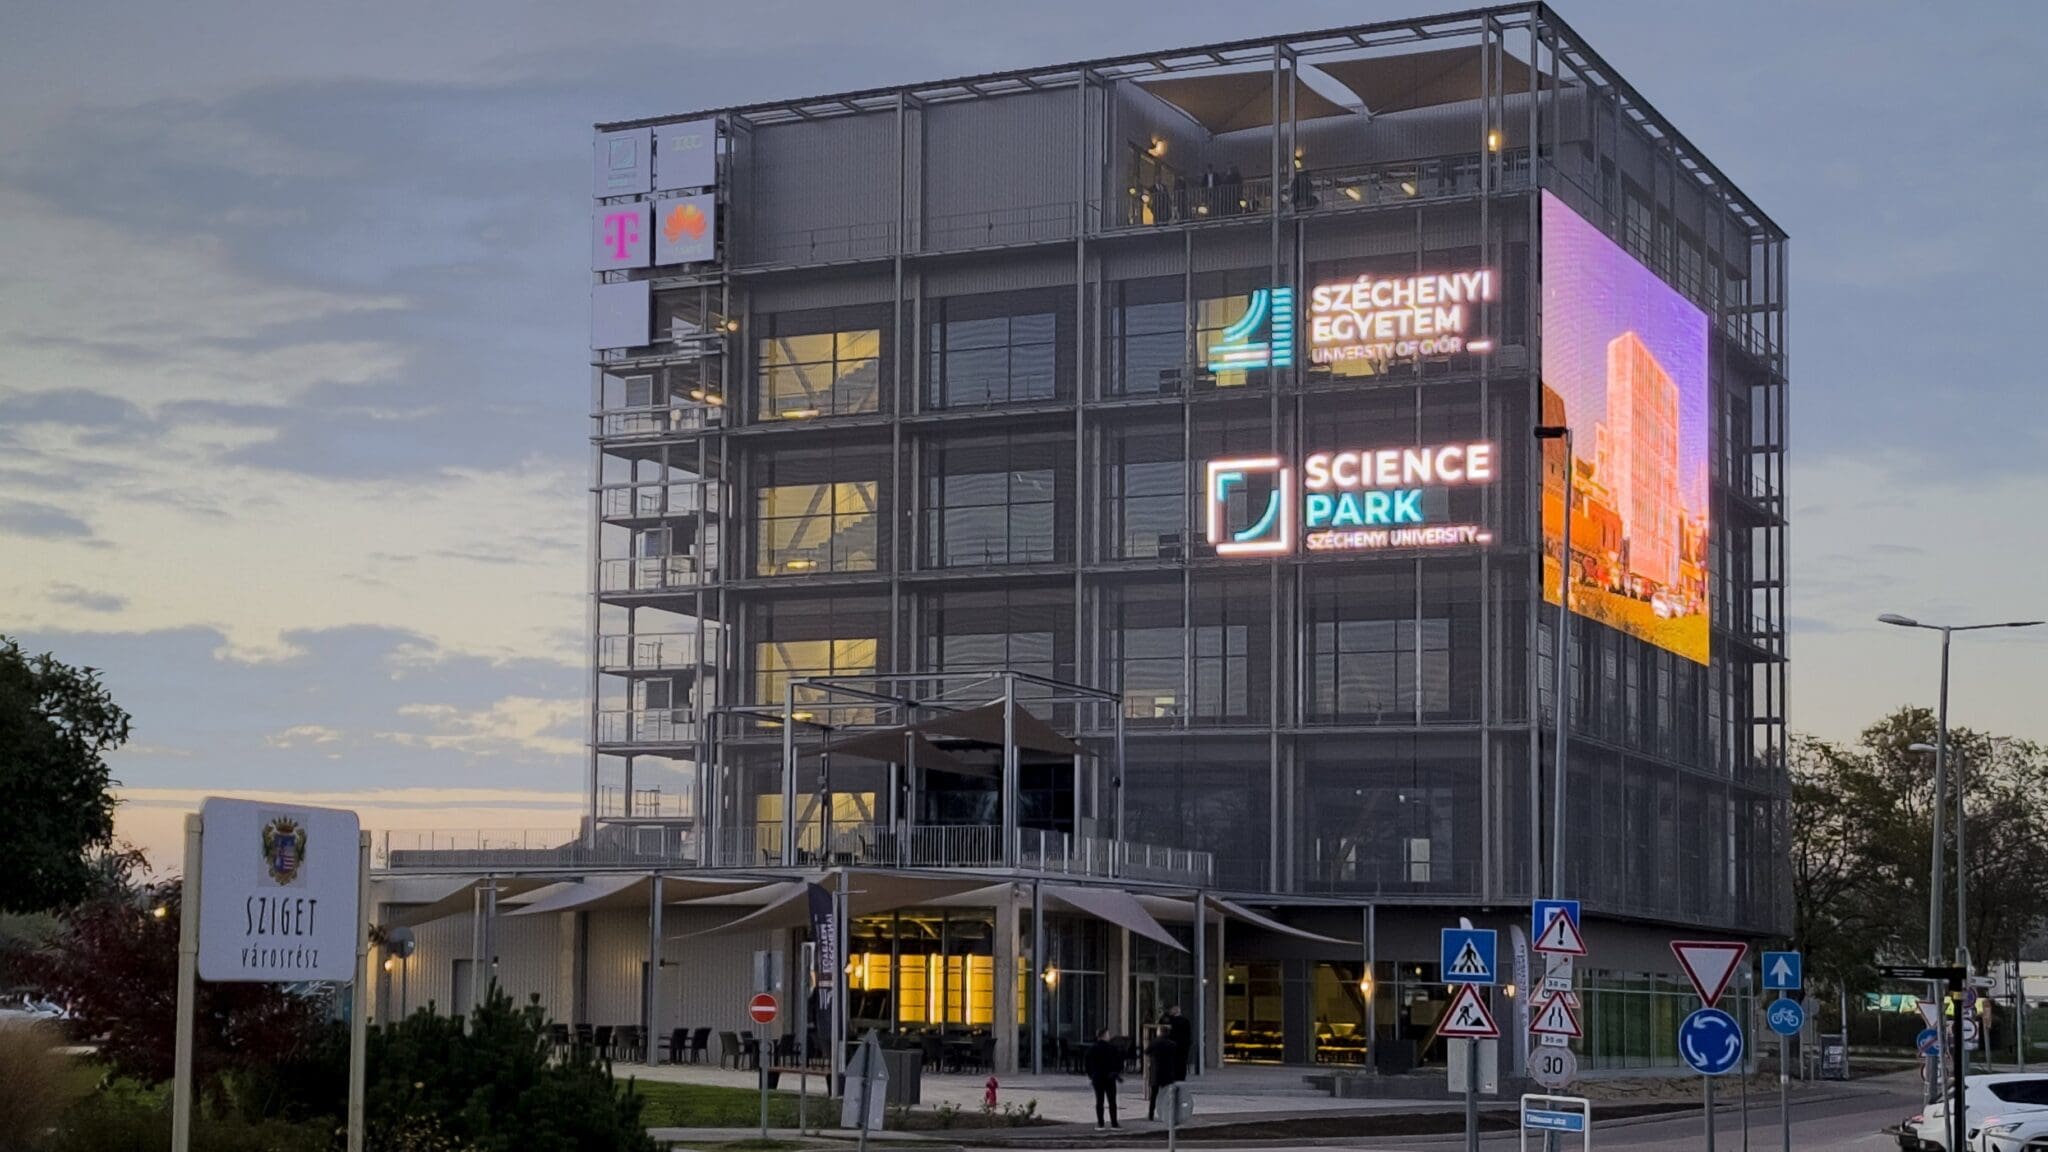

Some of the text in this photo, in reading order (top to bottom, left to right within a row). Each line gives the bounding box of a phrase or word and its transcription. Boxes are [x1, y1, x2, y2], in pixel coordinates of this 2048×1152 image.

[1312, 270, 1491, 313] SZÉCHENYI
[1312, 304, 1462, 343] EGYETEM
[1311, 335, 1462, 364] UNIVERSITY OF GYŐR
[1304, 444, 1491, 489] SCIENCE
[1306, 488, 1424, 528] PARK
[1306, 525, 1479, 550] SZÉCHENYI UNIVERSITY
[246, 896, 318, 937] SZIGET
[242, 942, 319, 969] városrész
[1542, 1055, 1564, 1075] 30
